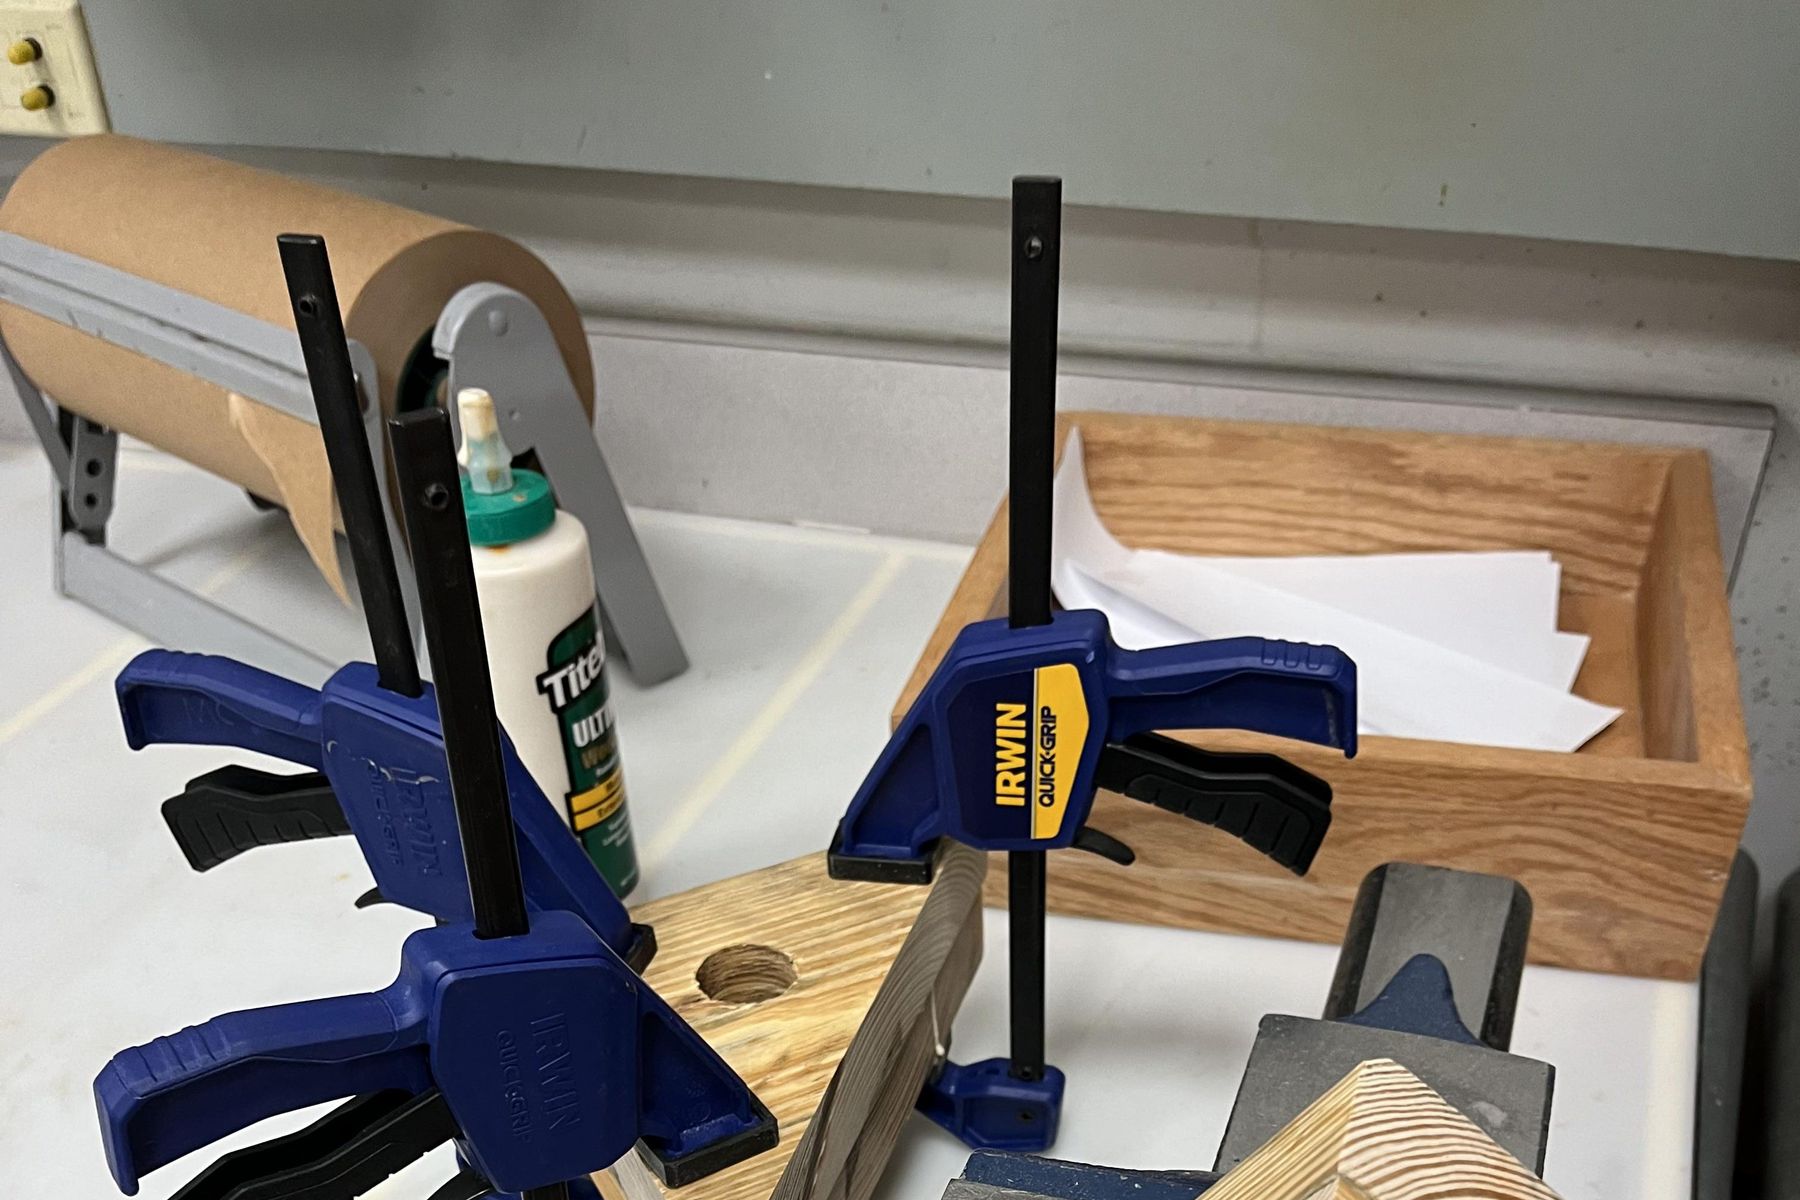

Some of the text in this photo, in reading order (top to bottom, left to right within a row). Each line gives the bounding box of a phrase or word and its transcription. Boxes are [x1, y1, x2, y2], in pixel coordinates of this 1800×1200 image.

[542, 629, 606, 708] Tite
[995, 703, 1027, 806] IRWIN
[530, 1012, 581, 1132] IRWIN
